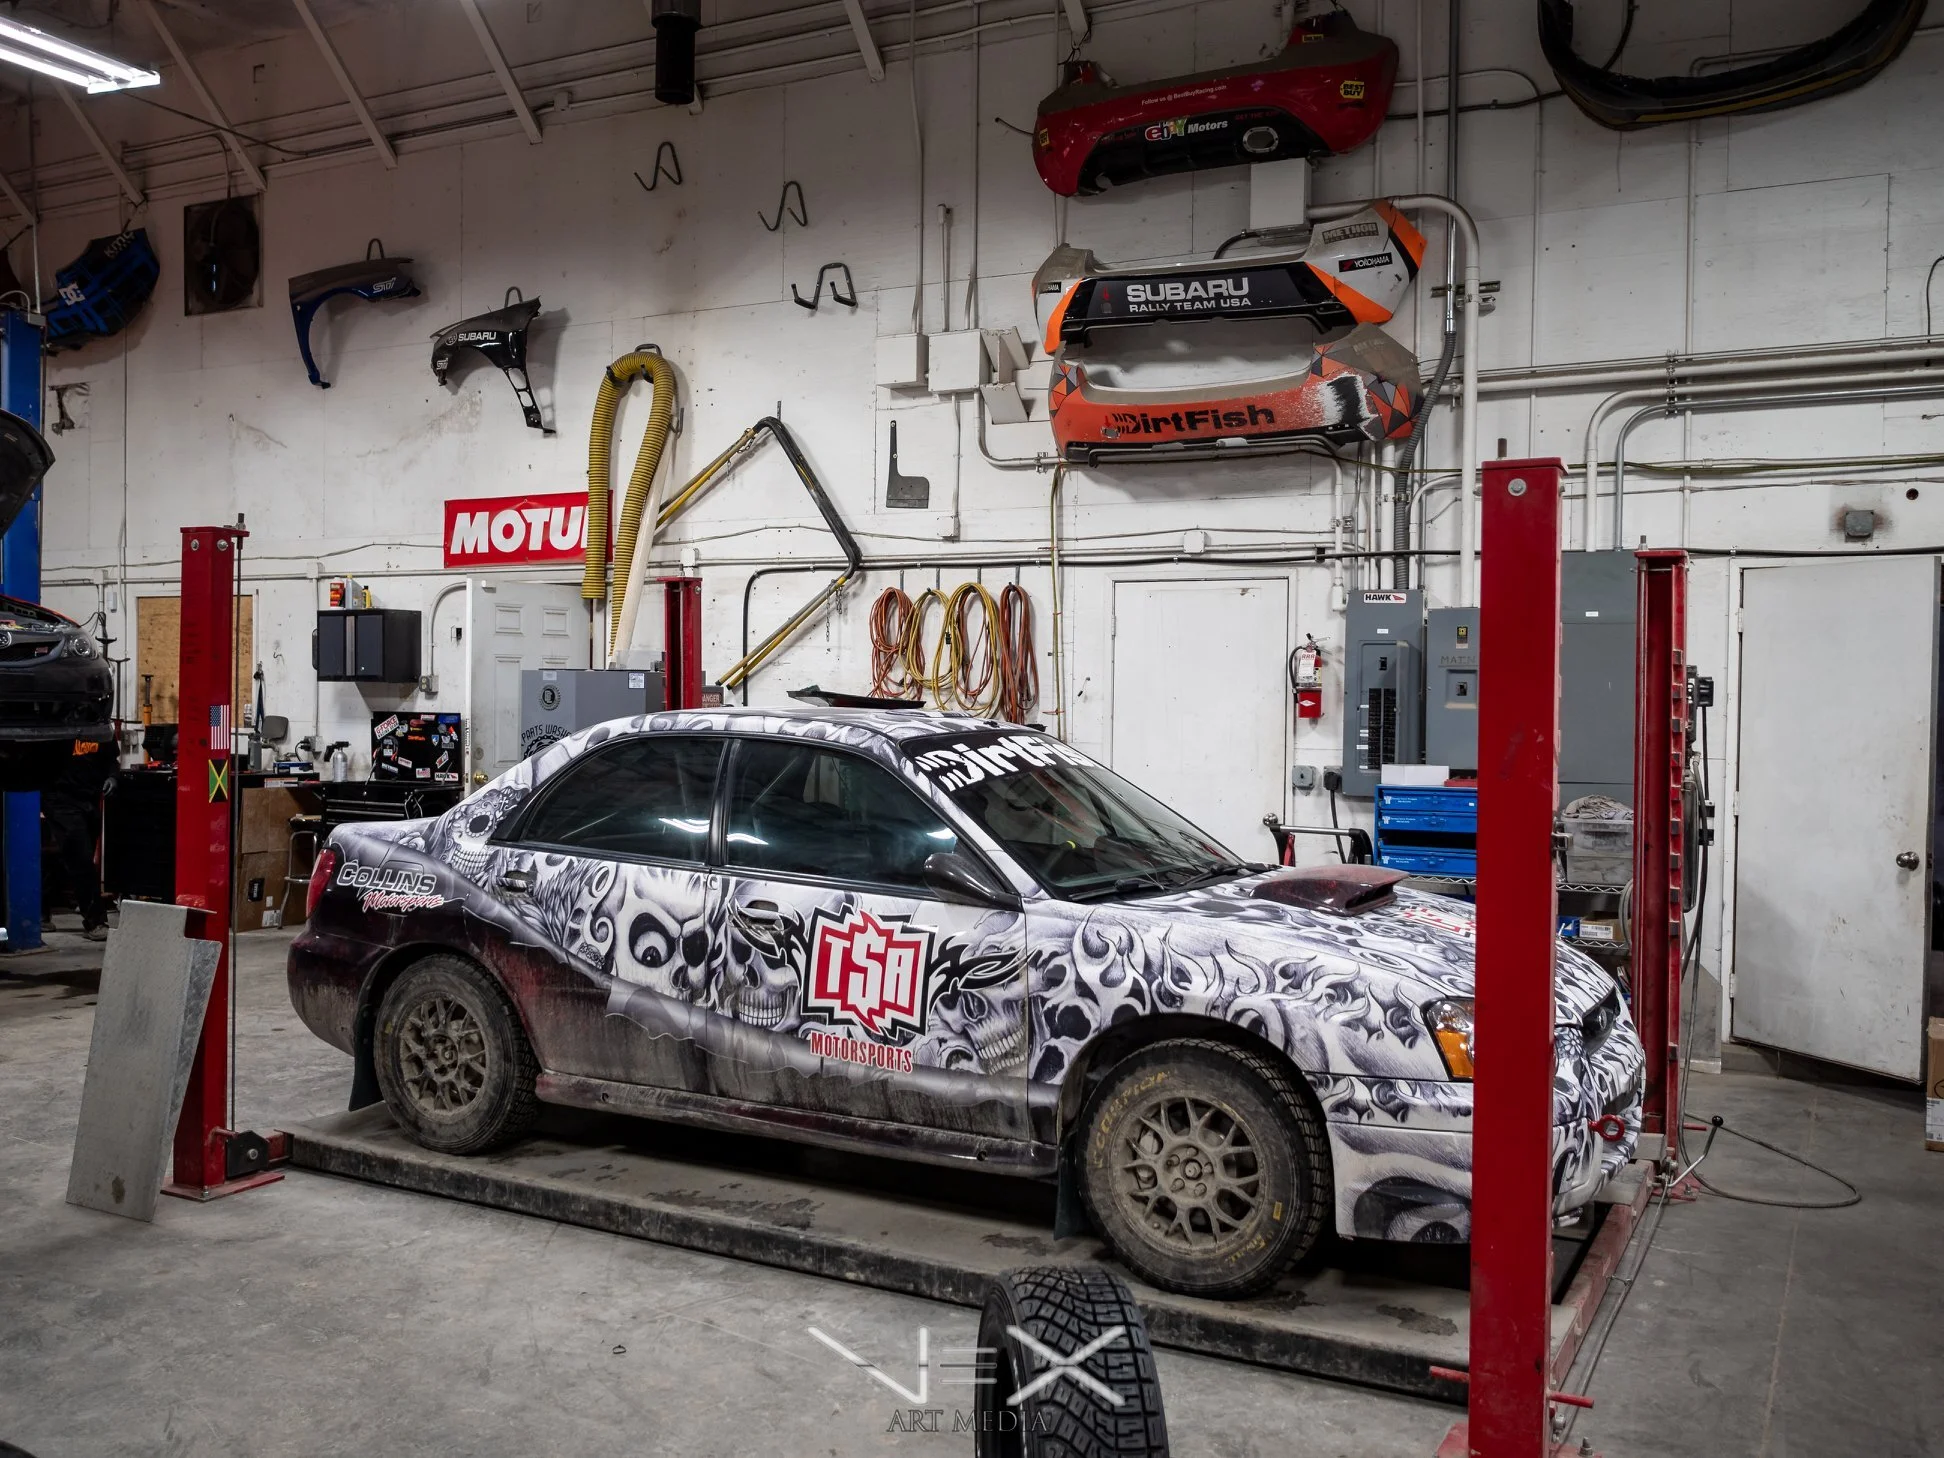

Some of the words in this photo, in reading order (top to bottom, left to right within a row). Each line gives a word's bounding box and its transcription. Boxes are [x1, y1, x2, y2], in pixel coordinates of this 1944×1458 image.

[1141, 98, 1159, 106] Follow
[1187, 120, 1228, 134] Motors
[1323, 223, 1378, 238] METHOD
[1354, 255, 1390, 268] YOKOHAMA
[1126, 276, 1249, 303] SUBARU
[1129, 302, 1170, 313] RALLY
[1174, 299, 1216, 310] TEAM
[1220, 297, 1252, 308] USA
[458, 331, 497, 341] SUBARU
[1111, 405, 1275, 434] DirtFish
[702, 694, 720, 702] ANGER
[521, 724, 543, 743] PARTS
[915, 736, 1103, 792] DirtFis
[825, 923, 915, 1020] TSA
[811, 1031, 913, 1073] MOTORSPORTS
